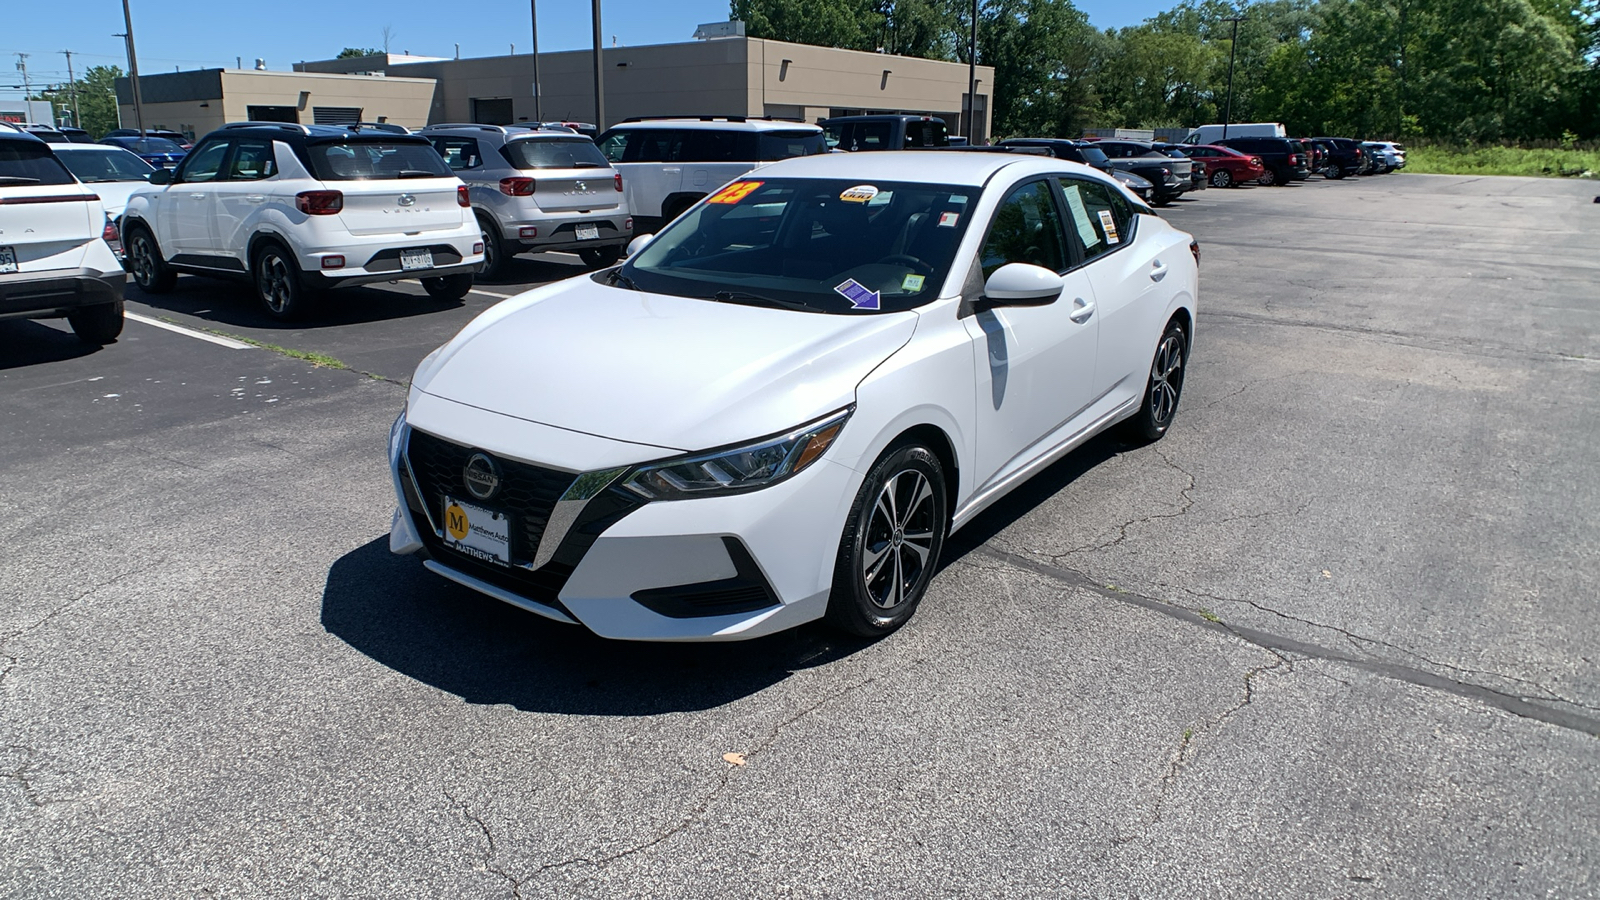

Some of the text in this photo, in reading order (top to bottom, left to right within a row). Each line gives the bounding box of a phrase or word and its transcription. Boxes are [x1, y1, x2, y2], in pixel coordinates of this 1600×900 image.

[709, 182, 760, 203] 23
[466, 470, 494, 483] NISSAN
[449, 512, 464, 533] M
[469, 523, 495, 538] Matthews
[494, 531, 509, 543] Auto
[455, 543, 494, 563] MATTHEWS
